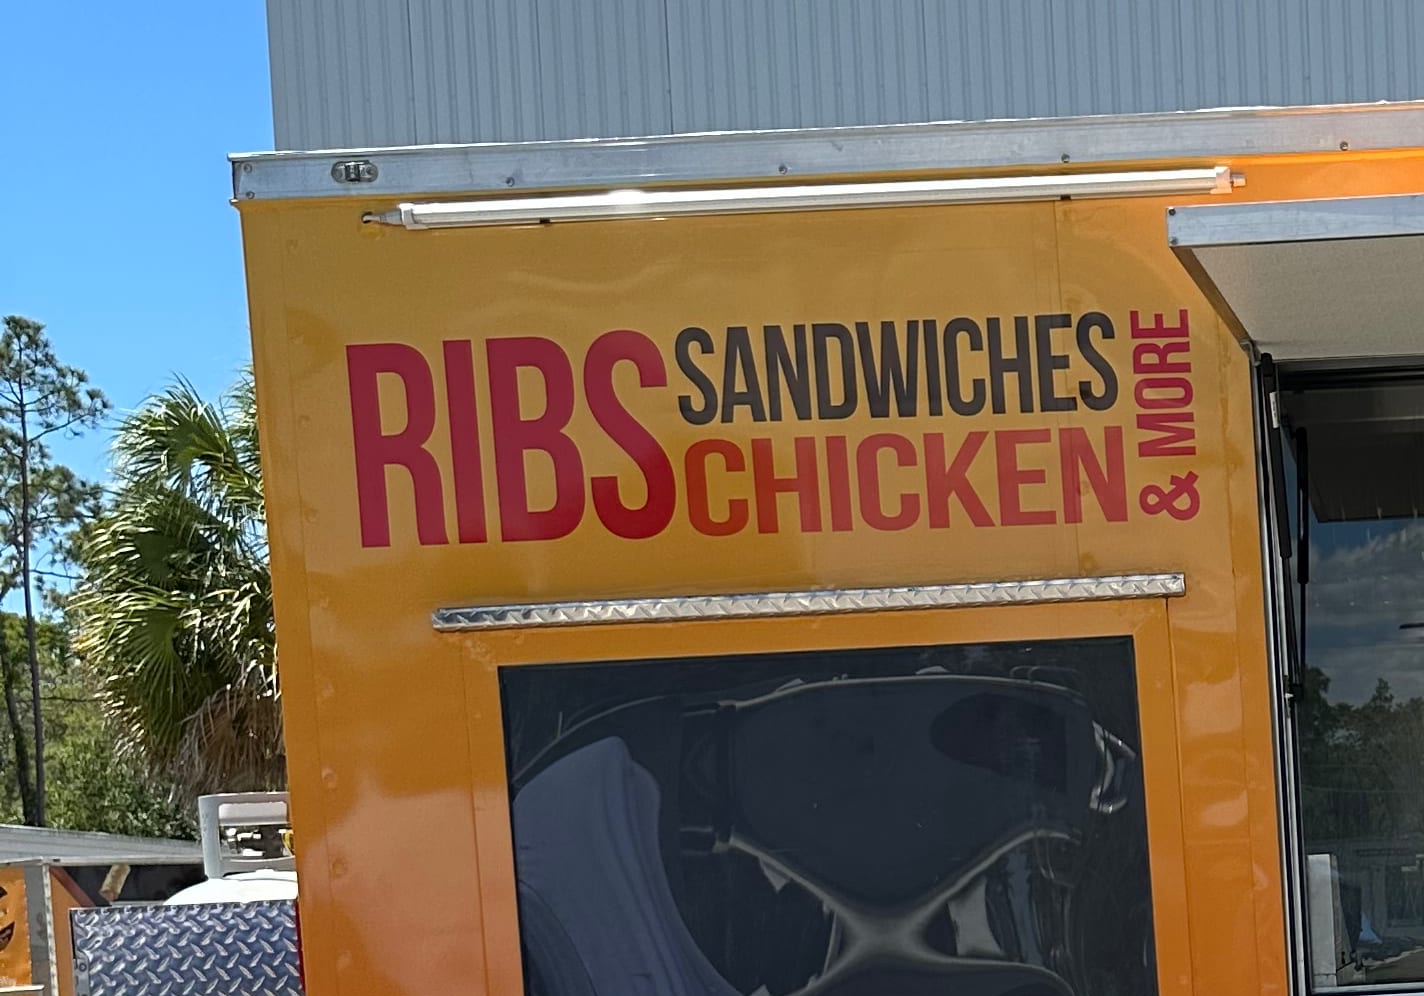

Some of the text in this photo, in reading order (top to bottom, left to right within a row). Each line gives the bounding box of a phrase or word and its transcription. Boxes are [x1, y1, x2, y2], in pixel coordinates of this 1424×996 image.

[345, 329, 678, 548] RIBS
[674, 311, 1119, 426] SANDWICHES
[1130, 308, 1201, 522] & MORE
[684, 425, 1129, 539] CHICKEN
